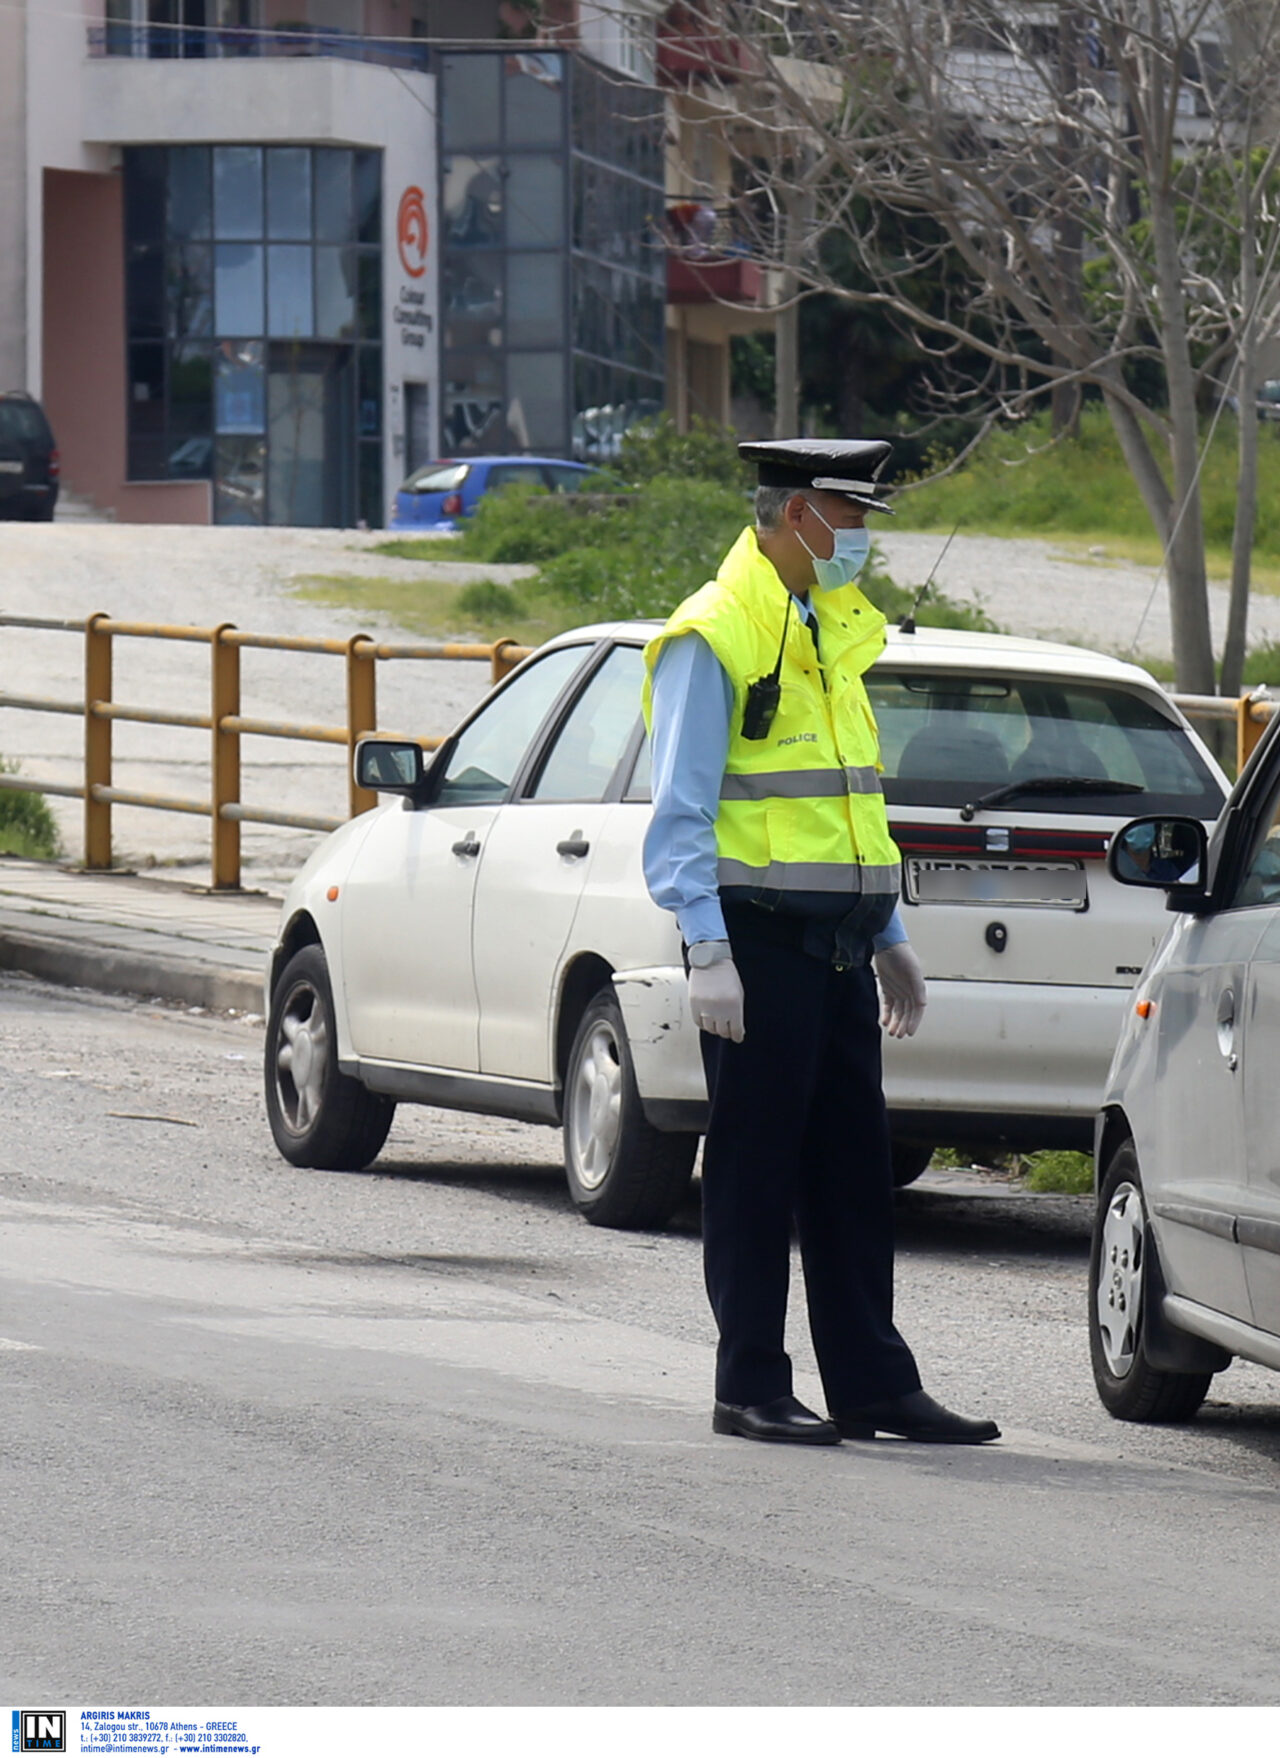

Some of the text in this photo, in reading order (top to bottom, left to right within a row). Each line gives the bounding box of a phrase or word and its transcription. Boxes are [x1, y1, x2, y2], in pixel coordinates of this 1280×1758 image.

[393, 305, 433, 334] Consulting
[401, 327, 425, 349] Group
[777, 732, 818, 748] POLICE
